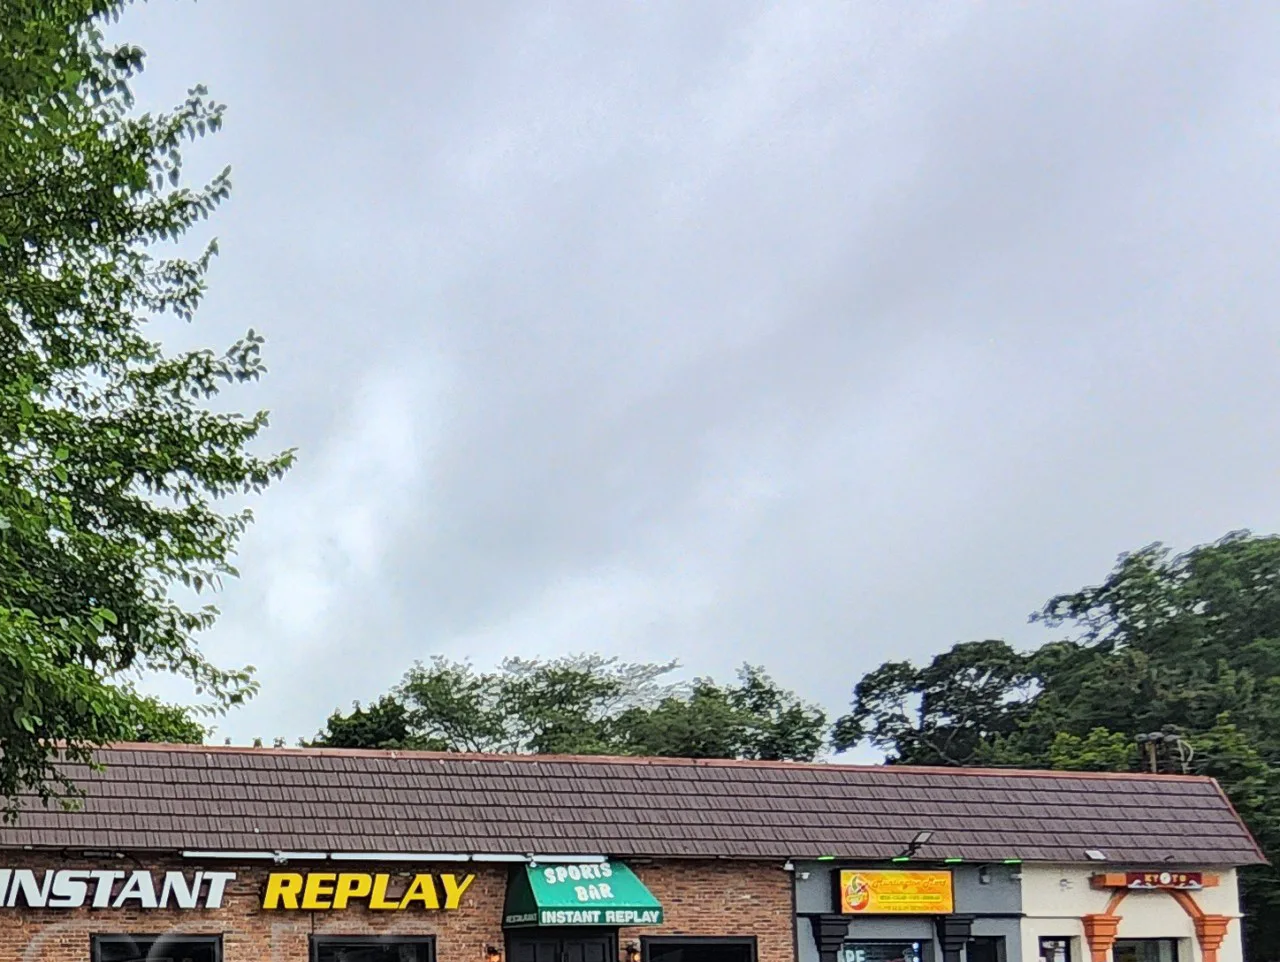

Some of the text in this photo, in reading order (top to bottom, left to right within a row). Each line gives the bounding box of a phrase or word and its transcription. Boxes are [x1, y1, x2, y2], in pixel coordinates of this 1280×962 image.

[543, 862, 613, 884] SPORTS
[263, 872, 476, 910] REPLAY
[574, 884, 614, 902] BAR
[541, 910, 601, 924] INSTANT
[605, 909, 660, 923] REPLAY
